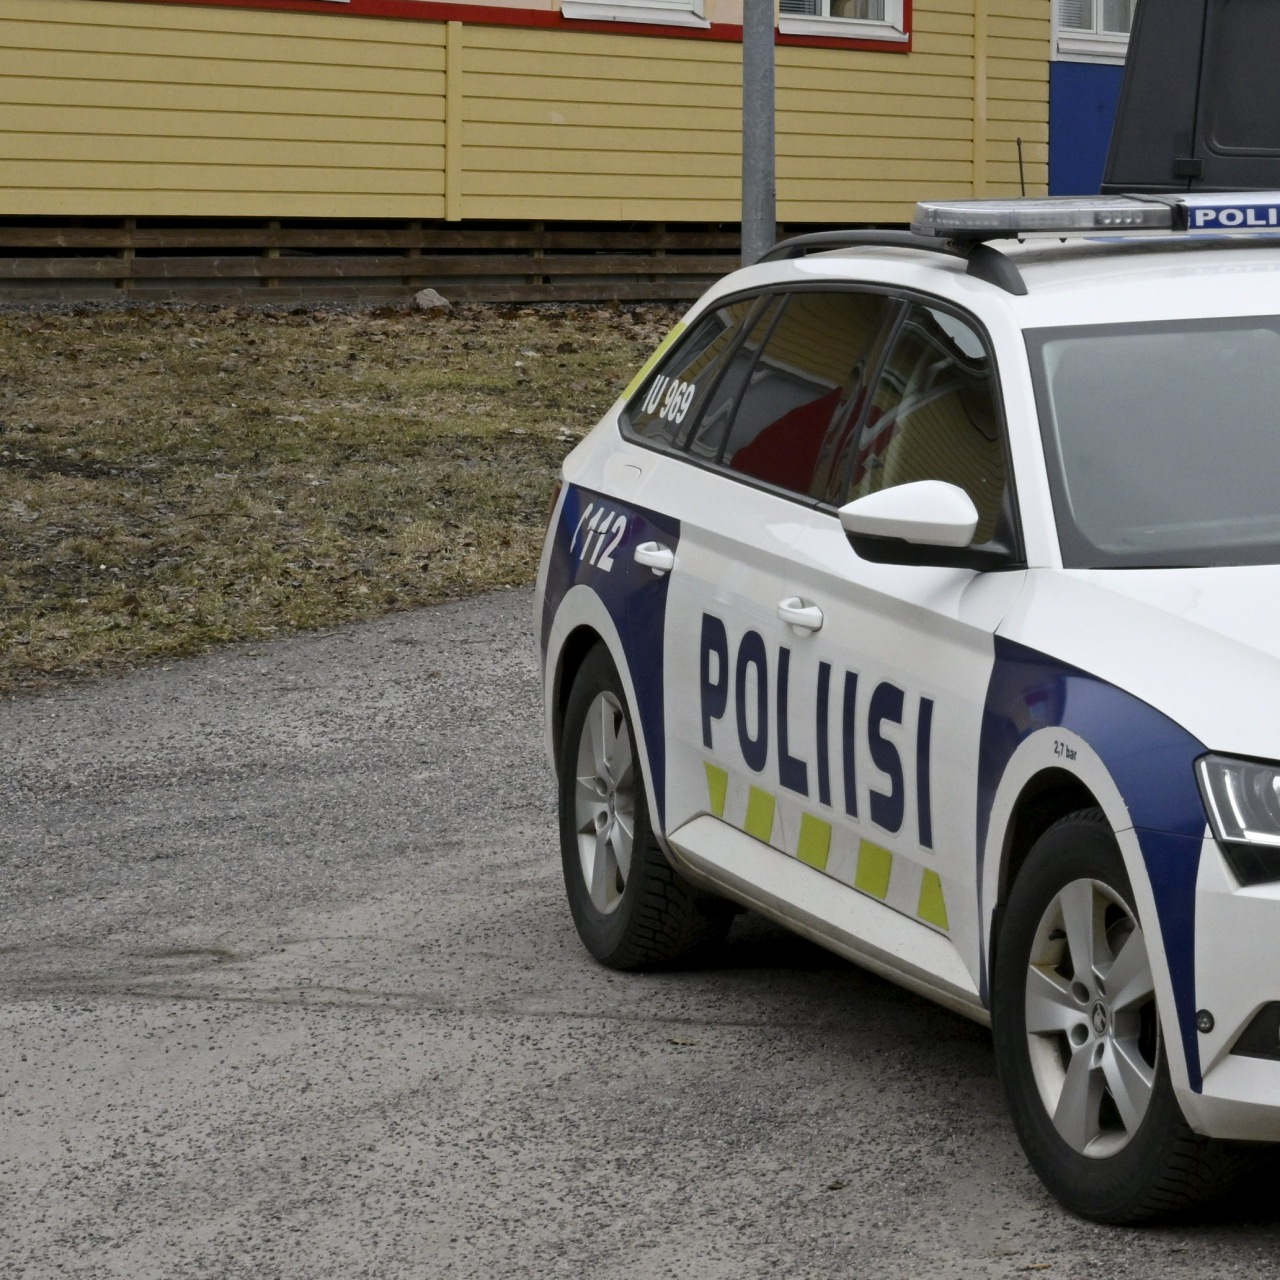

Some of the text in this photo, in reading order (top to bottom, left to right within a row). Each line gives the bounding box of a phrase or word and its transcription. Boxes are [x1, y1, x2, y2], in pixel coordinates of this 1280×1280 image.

[641, 374, 696, 424] IU 969
[579, 506, 627, 573] 112
[700, 611, 934, 850] POLIISI
[1066, 744, 1077, 761] bar
